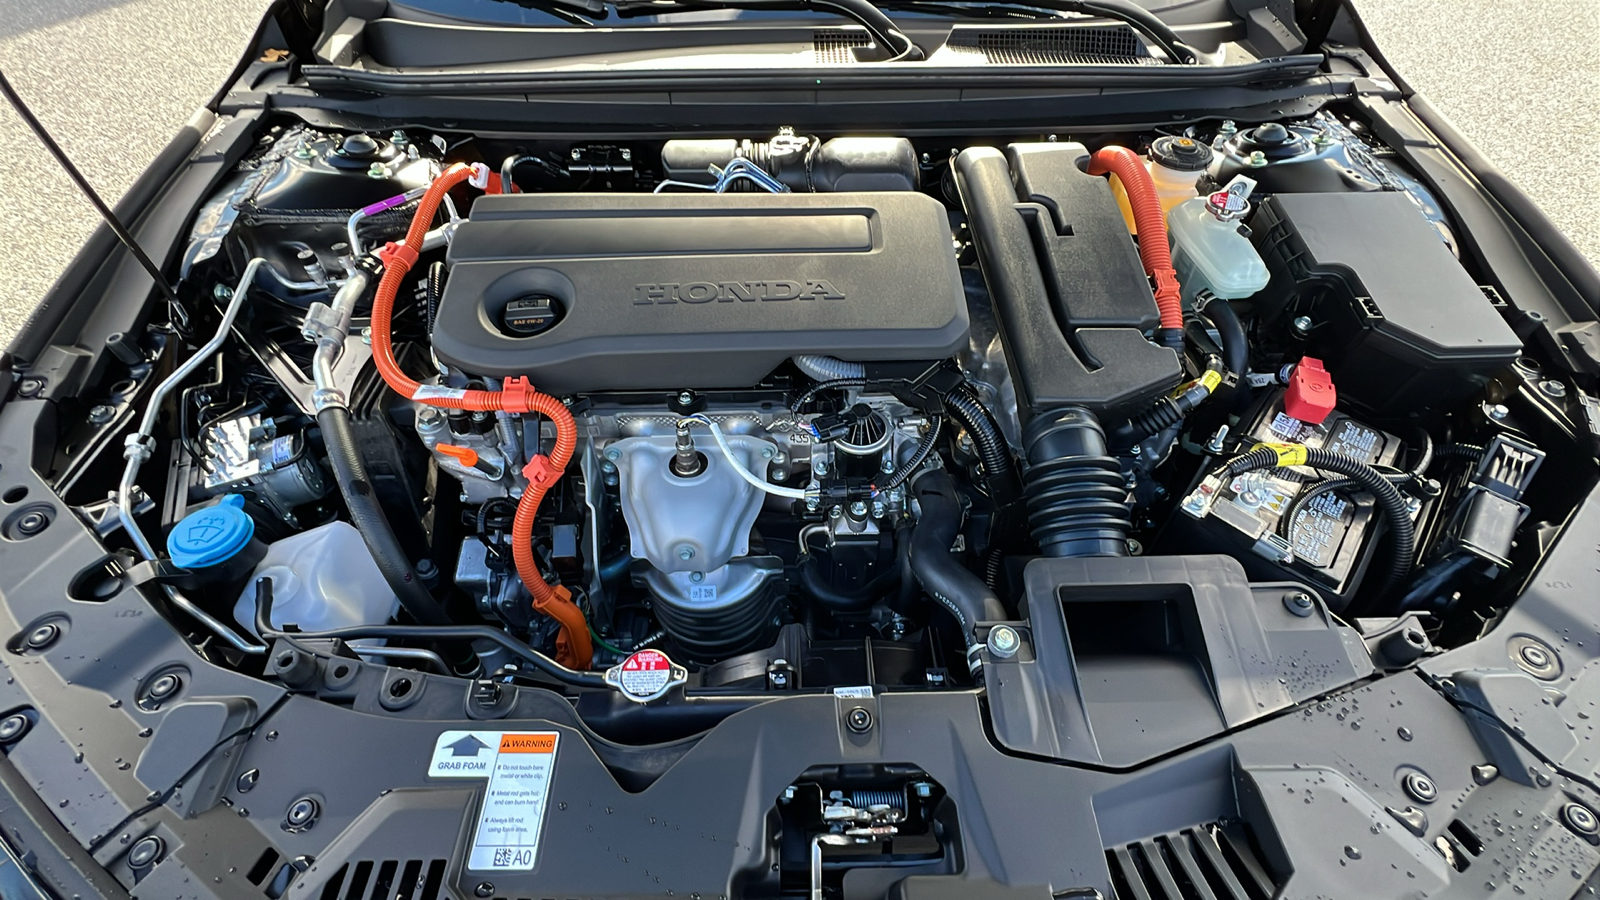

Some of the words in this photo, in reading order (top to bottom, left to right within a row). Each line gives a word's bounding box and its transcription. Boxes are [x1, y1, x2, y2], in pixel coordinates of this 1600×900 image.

[633, 279, 846, 305] HONDA
[790, 433, 809, 443] 435
[438, 762, 461, 770] GRAB
